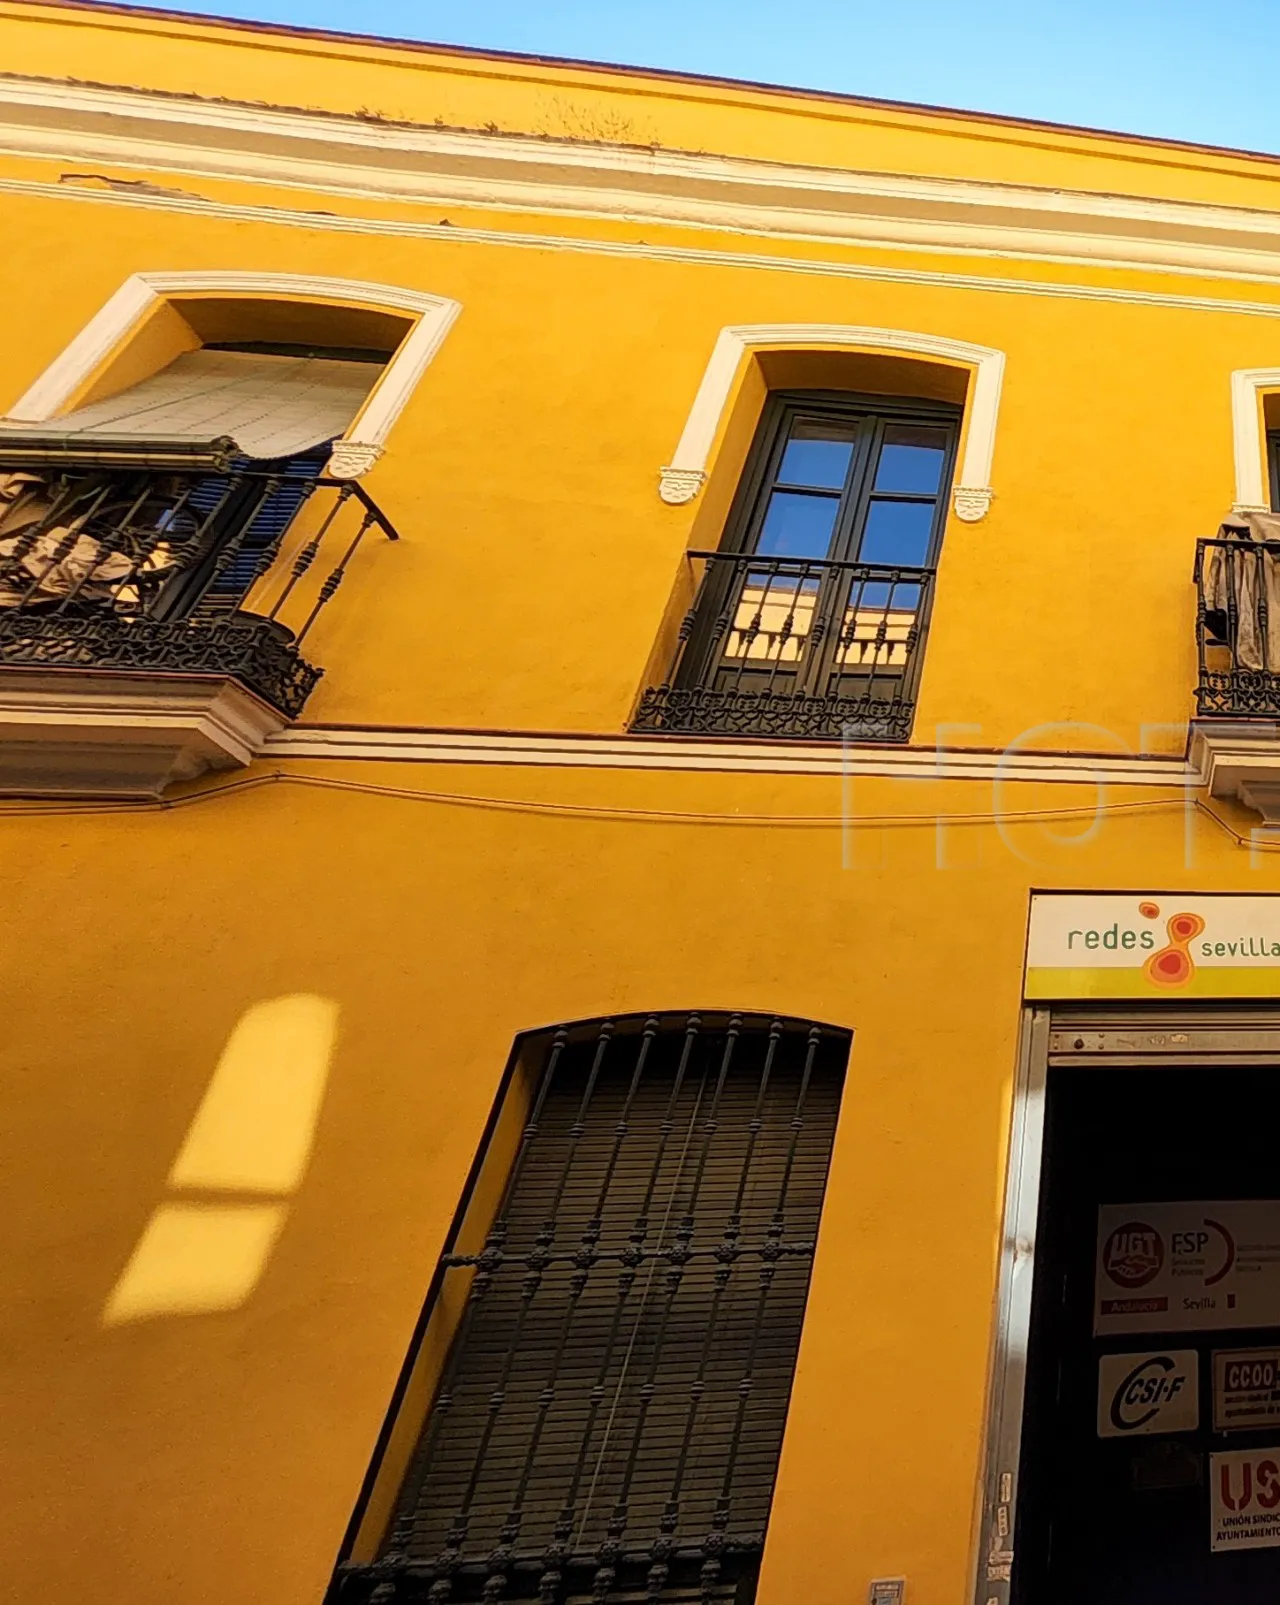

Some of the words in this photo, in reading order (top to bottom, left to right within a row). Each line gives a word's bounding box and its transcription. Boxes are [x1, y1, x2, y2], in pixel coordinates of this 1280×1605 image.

[1067, 923, 1155, 950] redes
[1110, 1231, 1157, 1255] UGT
[1171, 1232, 1209, 1254] FSP
[1182, 1297, 1216, 1311] Sevilla
[1222, 1514, 1251, 1527] UNIÓN
